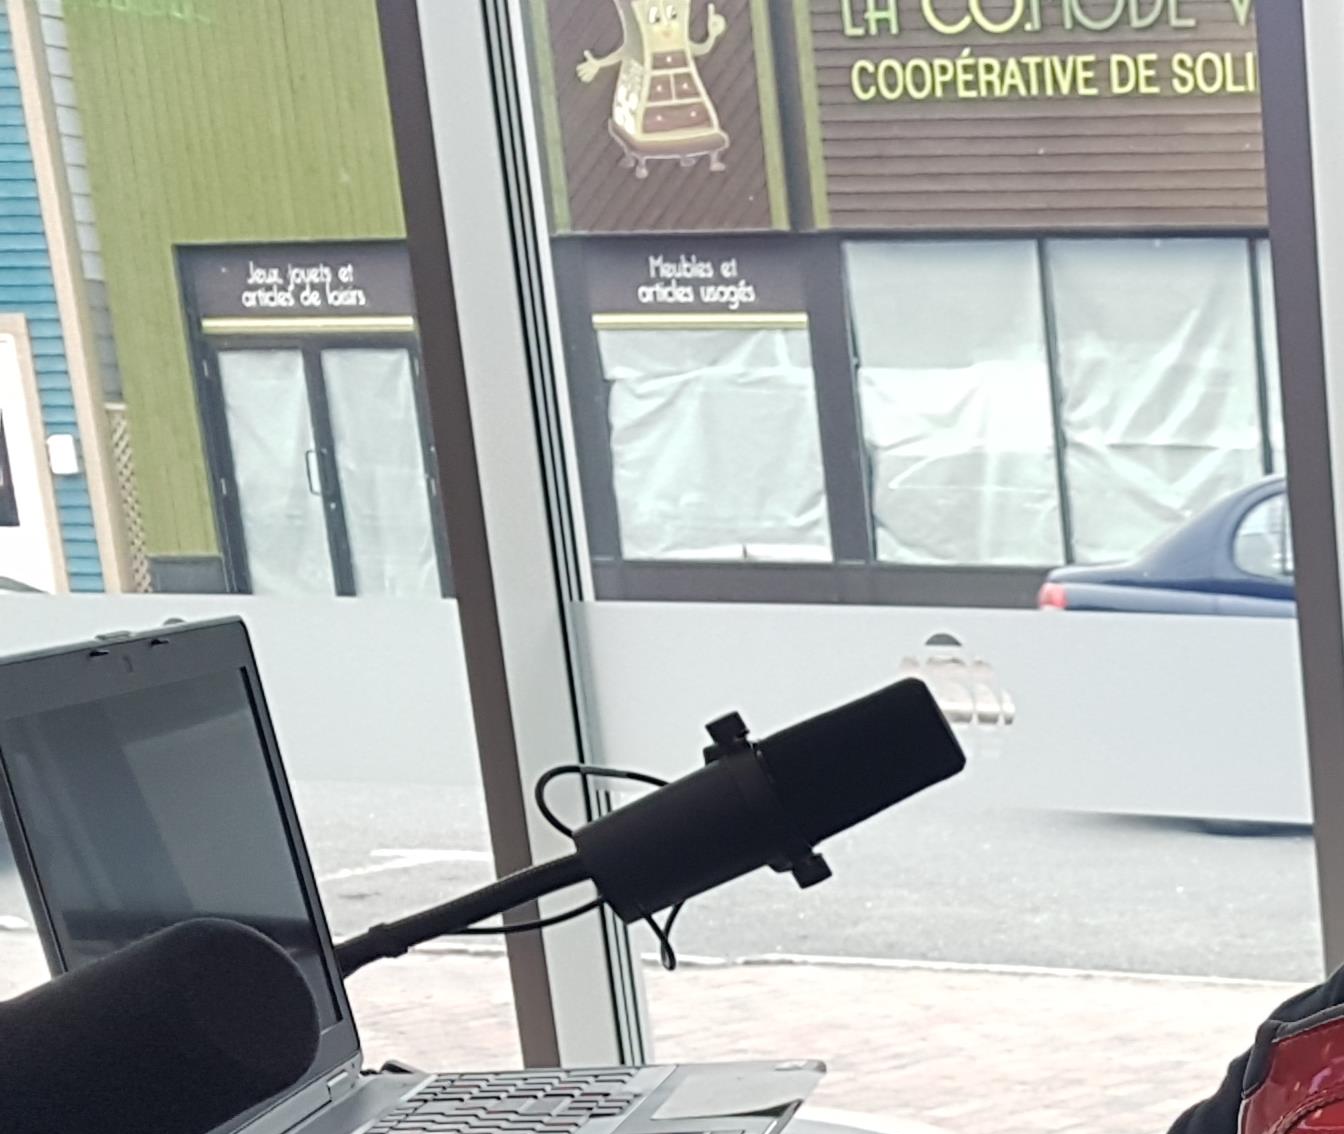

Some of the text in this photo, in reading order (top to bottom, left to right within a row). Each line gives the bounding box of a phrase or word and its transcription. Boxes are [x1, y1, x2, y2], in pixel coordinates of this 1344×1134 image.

[851, 49, 1099, 101] COOPÉRATIVE
[1110, 52, 1159, 94] DE
[338, 263, 353, 283] et
[648, 254, 738, 278] Meubles et
[241, 284, 295, 307] articles
[300, 283, 321, 306] de
[637, 279, 756, 309] articles usagés
